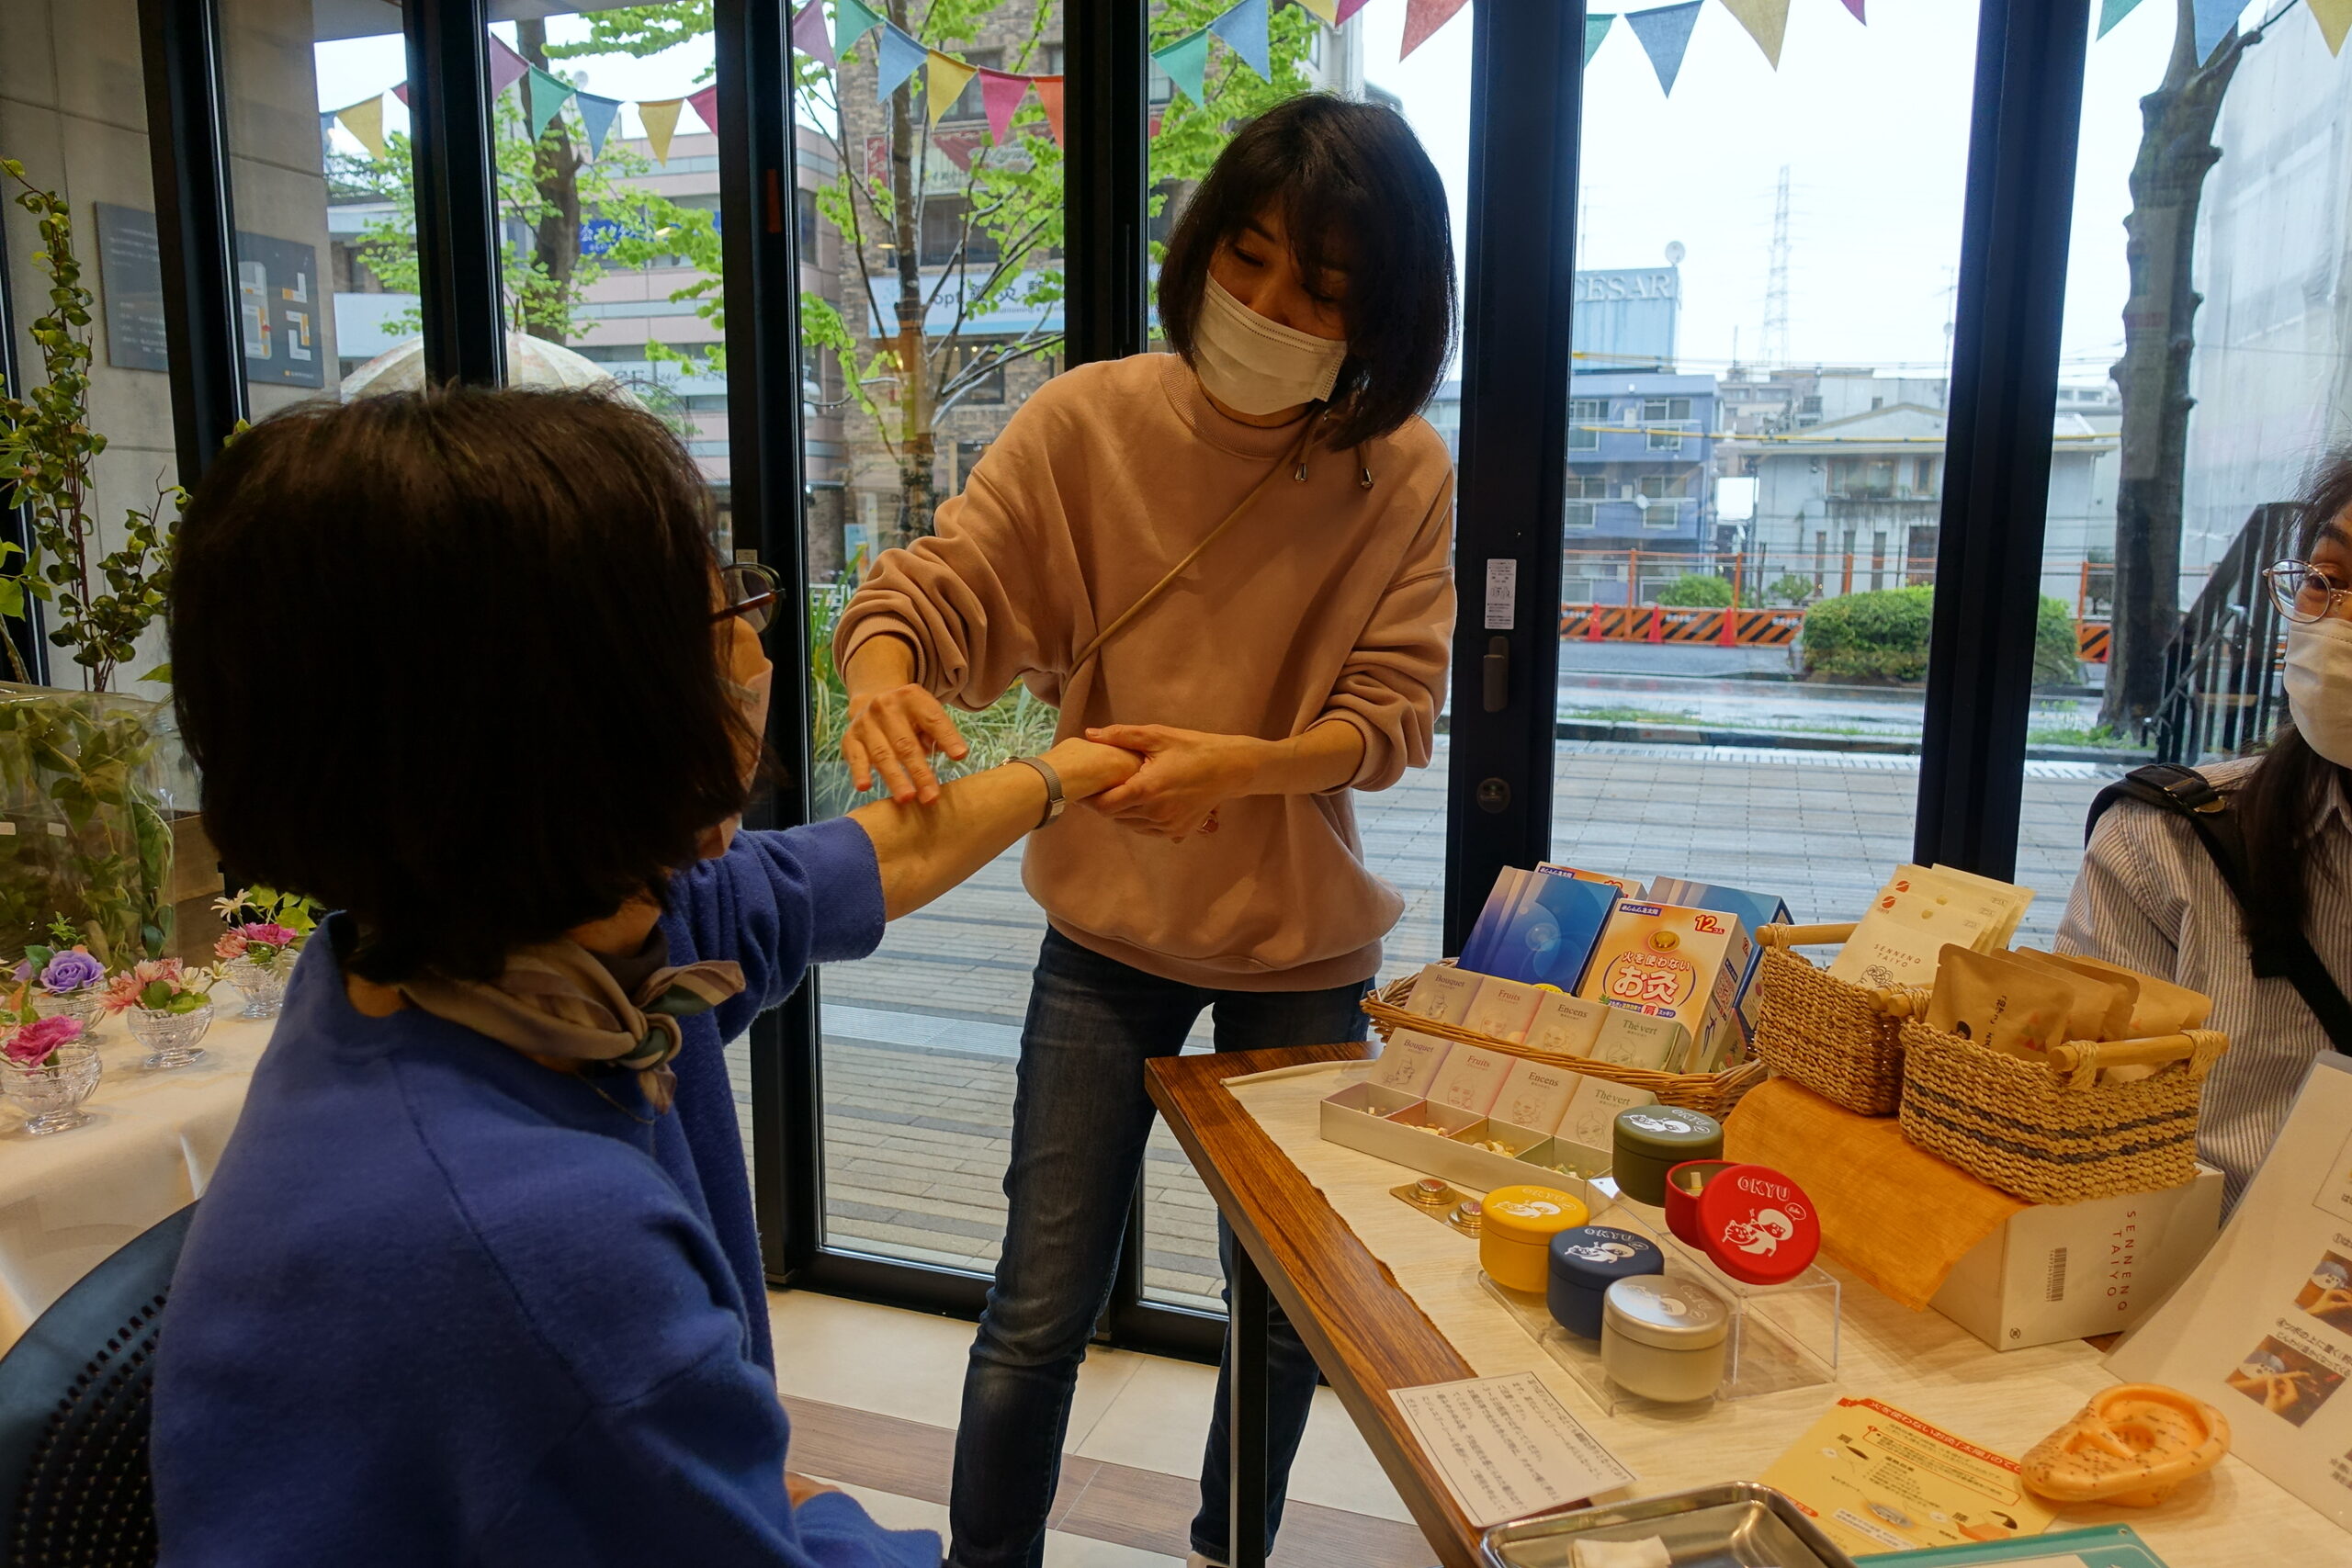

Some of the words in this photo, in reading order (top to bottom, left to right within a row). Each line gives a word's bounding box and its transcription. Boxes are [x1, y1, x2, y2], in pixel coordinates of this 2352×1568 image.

[1576, 275, 1674, 301] ESAR
[1622, 951, 1690, 971] 火を使わない
[1876, 953, 1908, 967] TAIYO
[1435, 974, 1464, 987] Bouquet
[1612, 965, 1679, 1004] お灸
[1498, 989, 1521, 1001] Fruits
[1557, 1004, 1589, 1019] Encens
[1639, 1024, 1657, 1035] vert
[1404, 1038, 1434, 1053] Bouquet
[1467, 1055, 1490, 1067] Fruits
[1528, 1071, 1559, 1087] Encens
[1612, 1095, 1631, 1106] vert
[1671, 1109, 1712, 1126] OKYU
[1521, 1187, 1568, 1202] OKYU
[1737, 1175, 1791, 1201] OKYU
[1584, 1227, 1635, 1242] OKYU
[2107, 1230, 2122, 1296] TAIYO
[2117, 1211, 2136, 1311] SENNENQ
